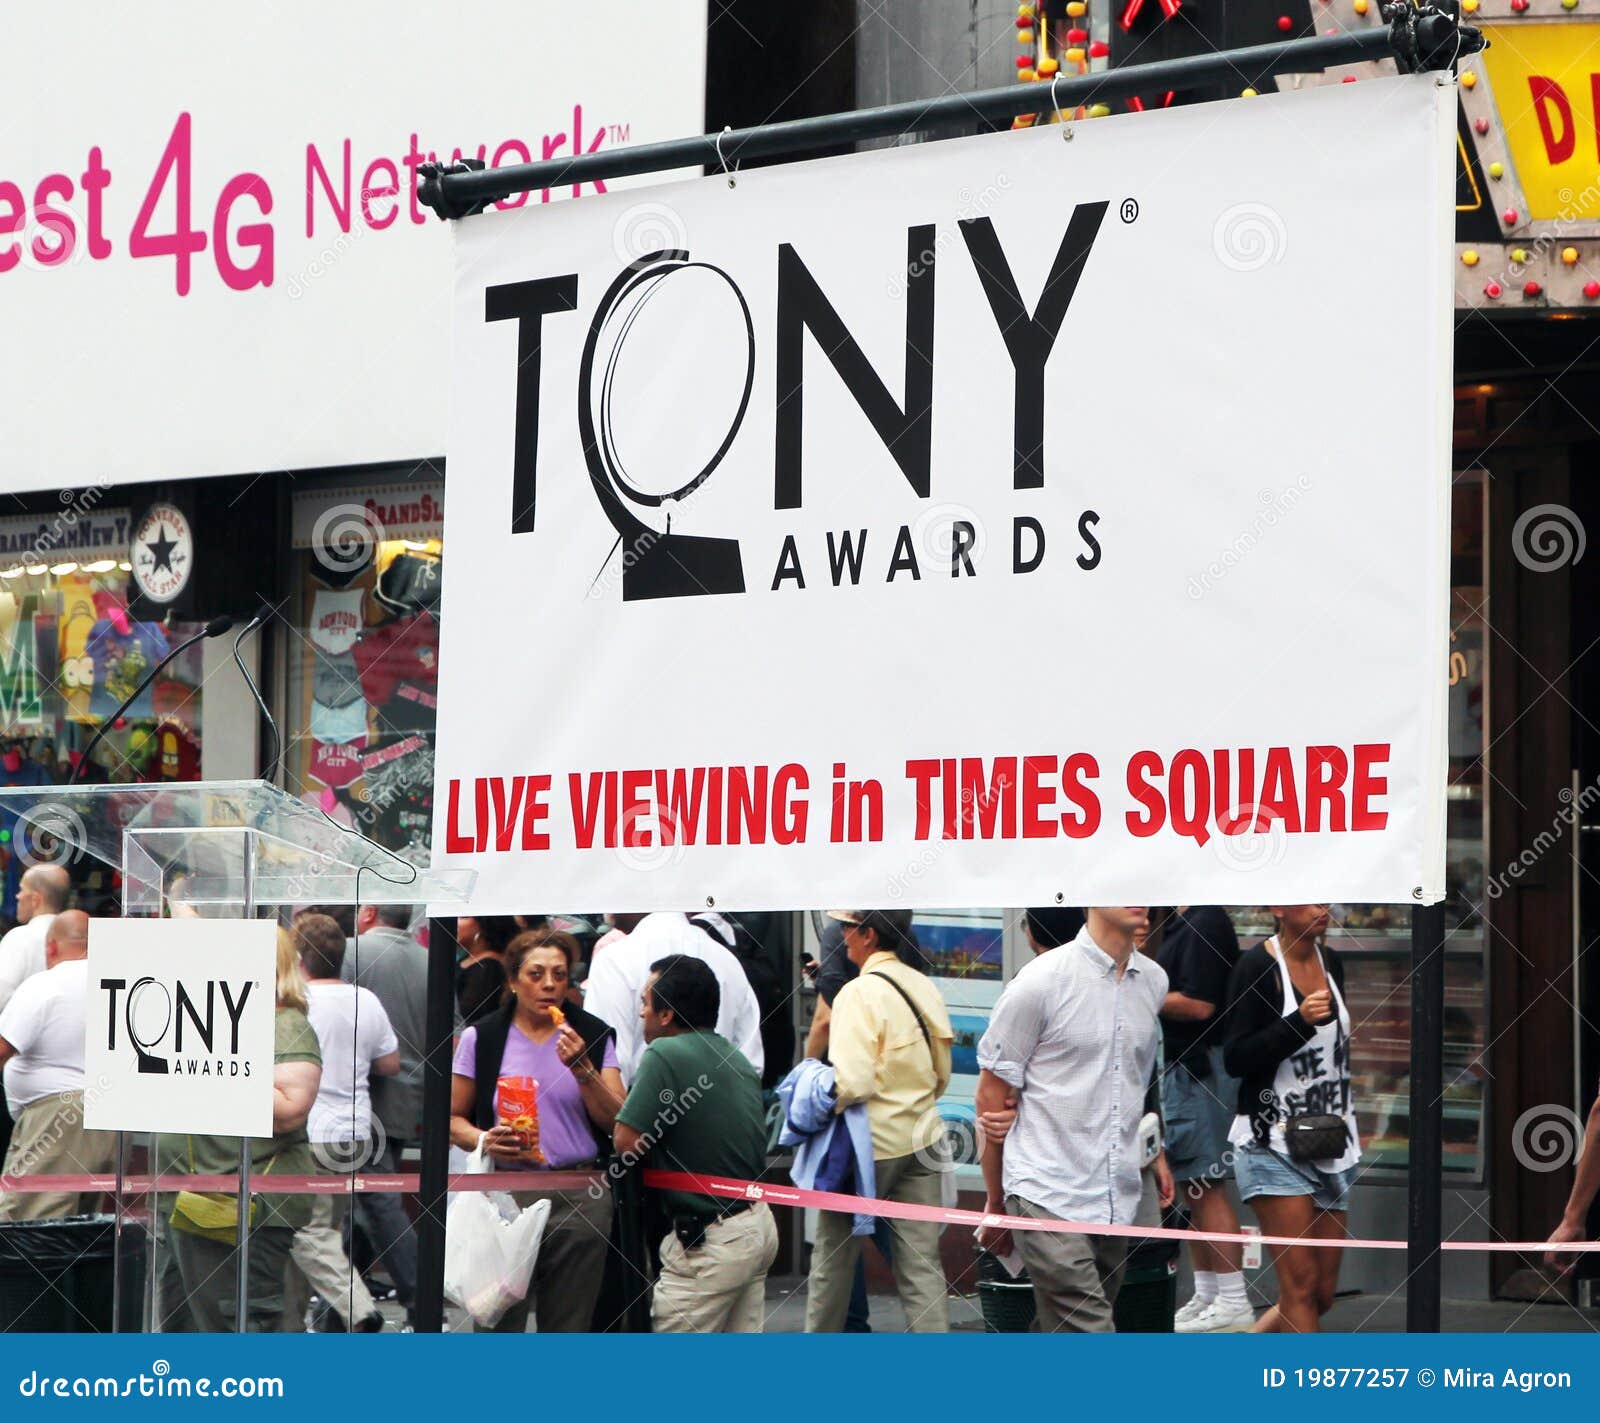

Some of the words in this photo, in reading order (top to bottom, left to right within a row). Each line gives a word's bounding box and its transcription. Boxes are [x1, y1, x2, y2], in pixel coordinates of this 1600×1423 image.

[129, 111, 274, 297] 4G
[485, 200, 1111, 602] TONY
[771, 510, 1102, 592] AWARDS
[446, 774, 552, 854] LIVE
[568, 762, 810, 850] VIEWING
[830, 762, 884, 844] in
[905, 752, 1101, 841] TIMES
[1126, 743, 1392, 848] SQUARE
[100, 976, 254, 1074] TONY
[174, 1058, 251, 1078] AWARDS
